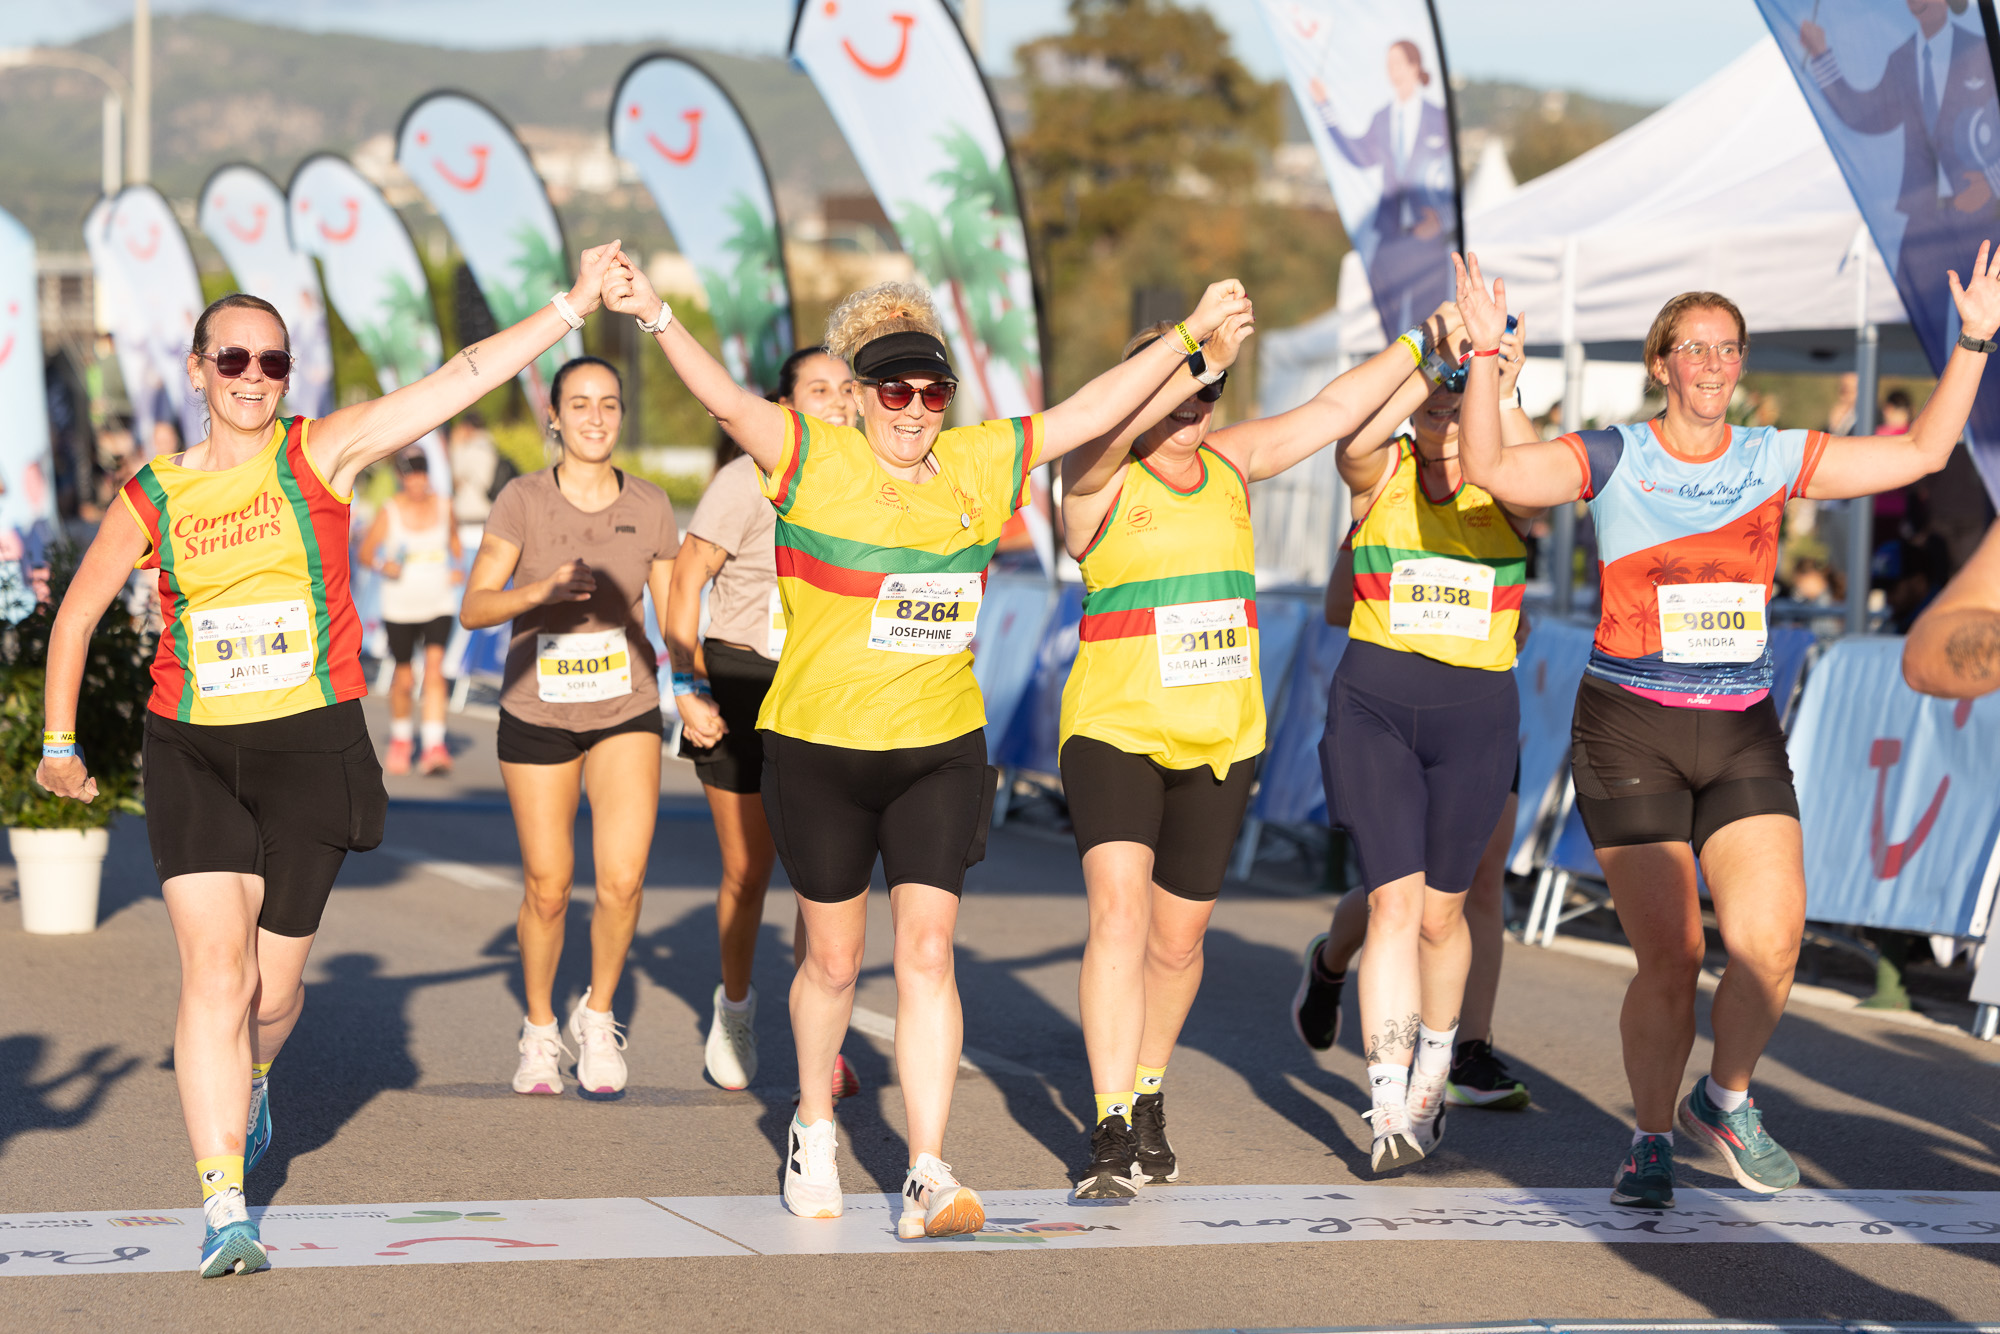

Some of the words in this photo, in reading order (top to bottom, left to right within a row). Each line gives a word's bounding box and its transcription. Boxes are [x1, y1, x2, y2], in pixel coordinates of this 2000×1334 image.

[1678, 483, 1715, 499] Palma
[174, 490, 283, 539] Cornelly
[184, 518, 281, 561] Striders
[1411, 584, 1470, 606] 8358
[896, 599, 960, 622] 8264
[1422, 609, 1450, 620] ALEX
[1683, 611, 1745, 630] 9800
[889, 625, 952, 640] JOSEPHINE
[1181, 628, 1236, 652] 9118
[216, 632, 288, 661] 9114
[1687, 637, 1736, 648] SANDRA
[229, 663, 270, 679] JAYNE
[557, 655, 611, 675] 8401
[1167, 658, 1208, 672] SARAH
[1216, 654, 1241, 667] JAYNE
[567, 680, 597, 690] SOFIA
[1409, 1207, 1723, 1218] MALLORCA
